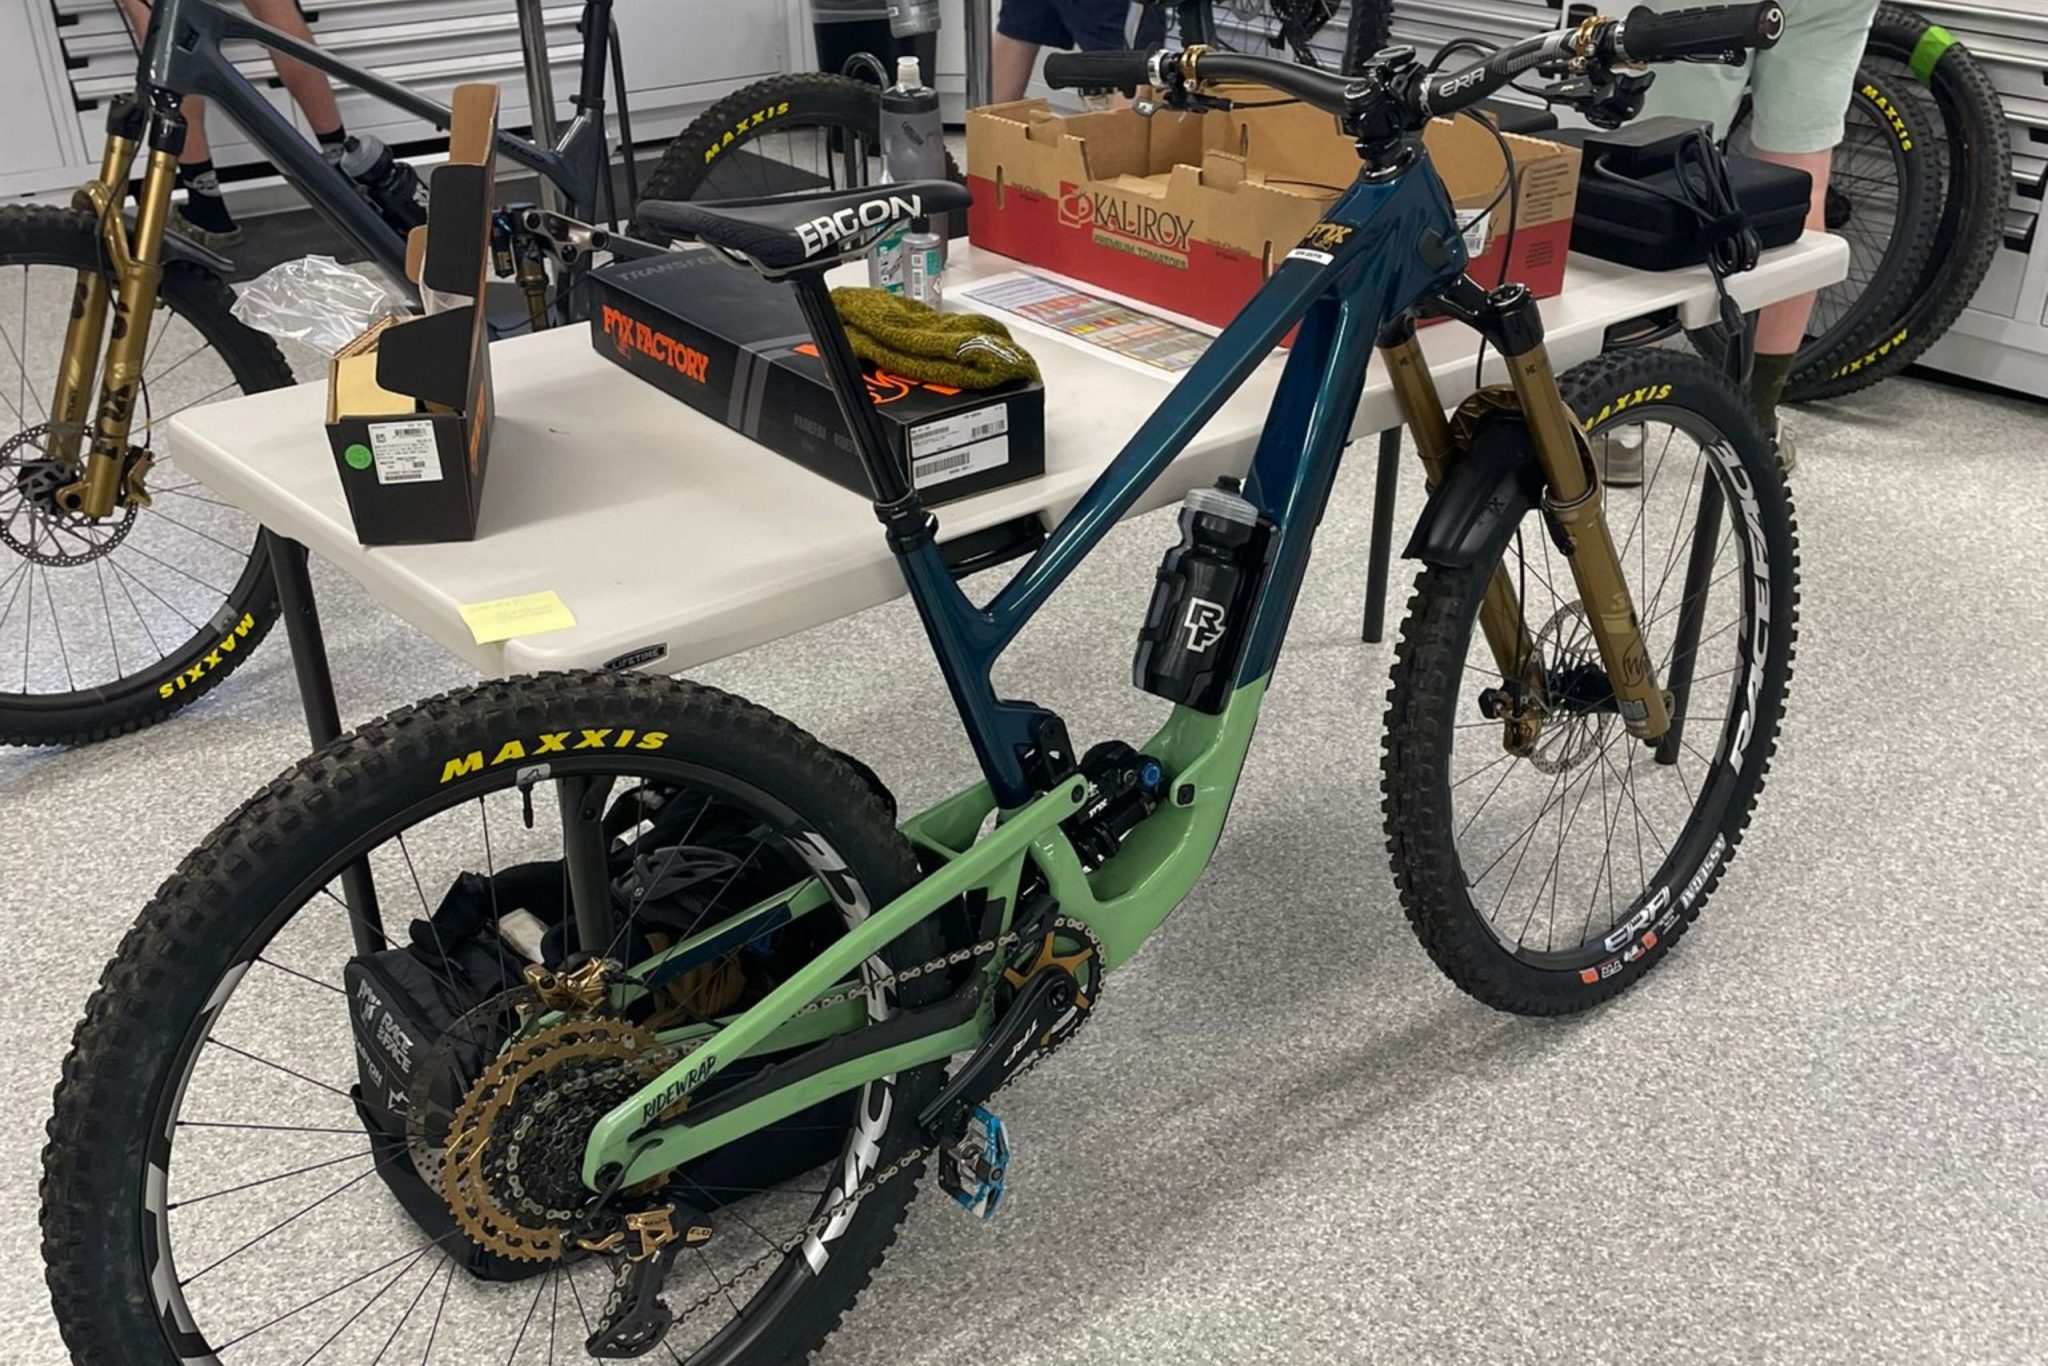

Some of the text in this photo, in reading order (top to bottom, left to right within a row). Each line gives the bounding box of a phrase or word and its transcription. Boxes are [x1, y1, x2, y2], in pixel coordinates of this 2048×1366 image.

[1438, 66, 1486, 97] ERA
[704, 102, 790, 165] MAXXIS
[1861, 84, 1912, 151] MAXXIS
[795, 194, 922, 258] ERGON
[1094, 192, 1194, 250] KALIROY
[1306, 224, 1354, 250] FOX
[602, 303, 710, 384] FOX FACTORY
[160, 612, 255, 699] MAXXIS
[611, 649, 659, 670] LIFETIME
[440, 729, 669, 784] MAXXIS
[381, 1011, 414, 1055] RACE
[643, 1056, 717, 1123] RIDEWRAP
